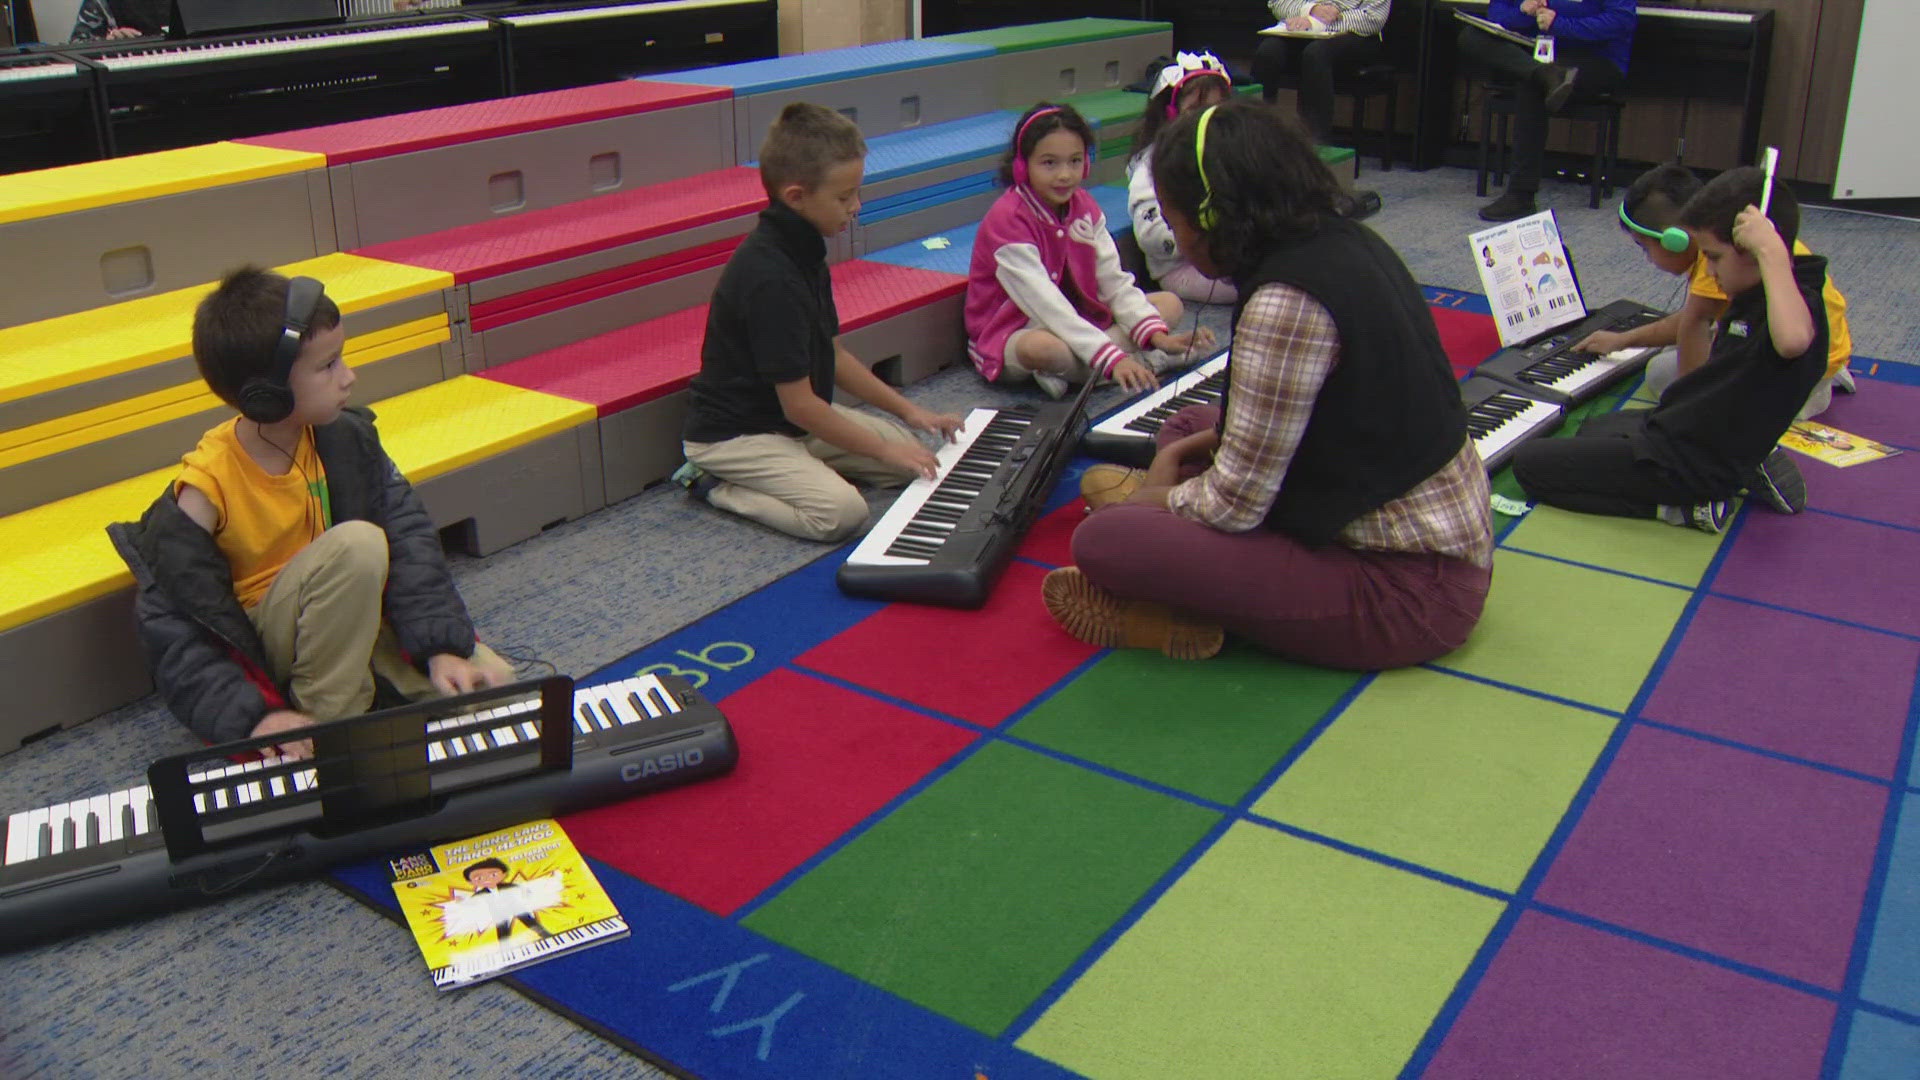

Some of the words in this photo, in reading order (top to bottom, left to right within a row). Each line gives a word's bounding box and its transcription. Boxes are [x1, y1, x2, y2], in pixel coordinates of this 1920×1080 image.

[620, 748, 705, 782] CASIO
[444, 845, 469, 858] THE
[473, 833, 510, 850] LANG
[513, 823, 550, 838] LANG
[447, 847, 493, 866] PIANO
[495, 830, 554, 853] METHOD
